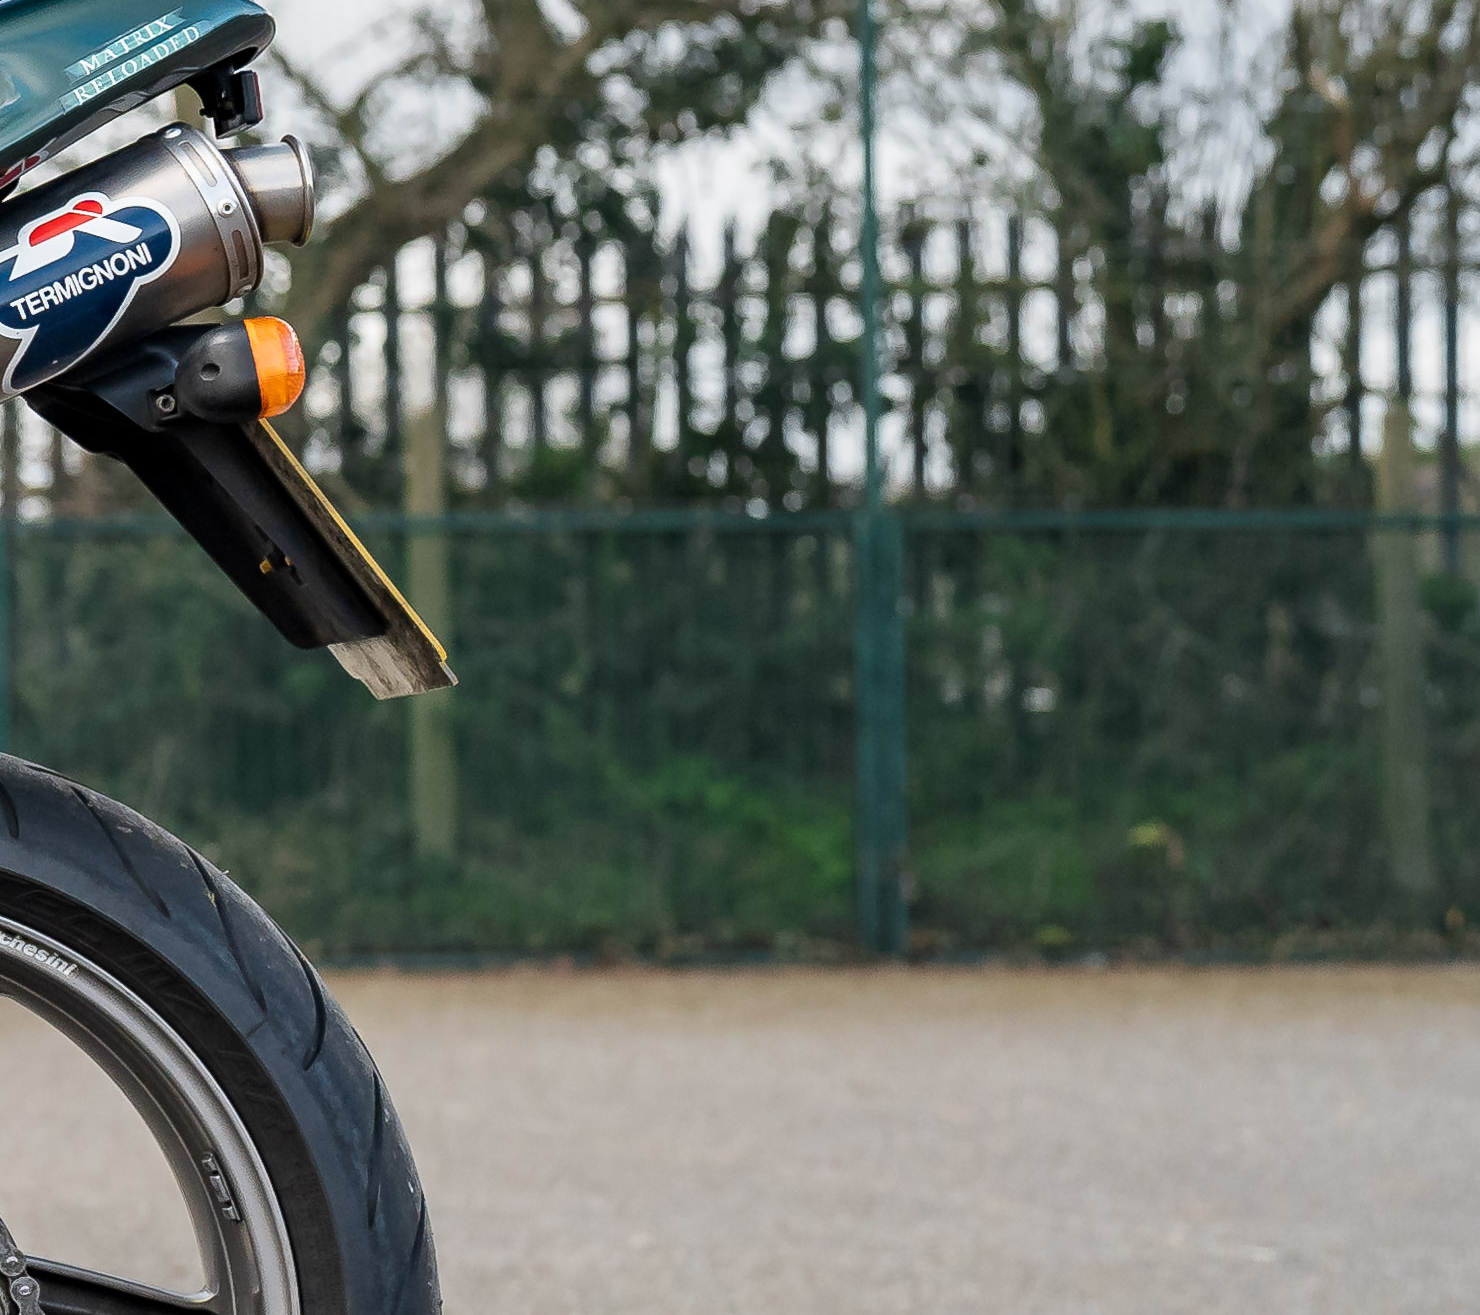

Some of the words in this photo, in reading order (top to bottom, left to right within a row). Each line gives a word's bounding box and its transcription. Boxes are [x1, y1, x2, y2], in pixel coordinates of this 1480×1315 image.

[73, 26, 200, 105] RELOADED
[79, 16, 174, 76] MATRIX
[10, 242, 152, 320] TERMIGNONI
